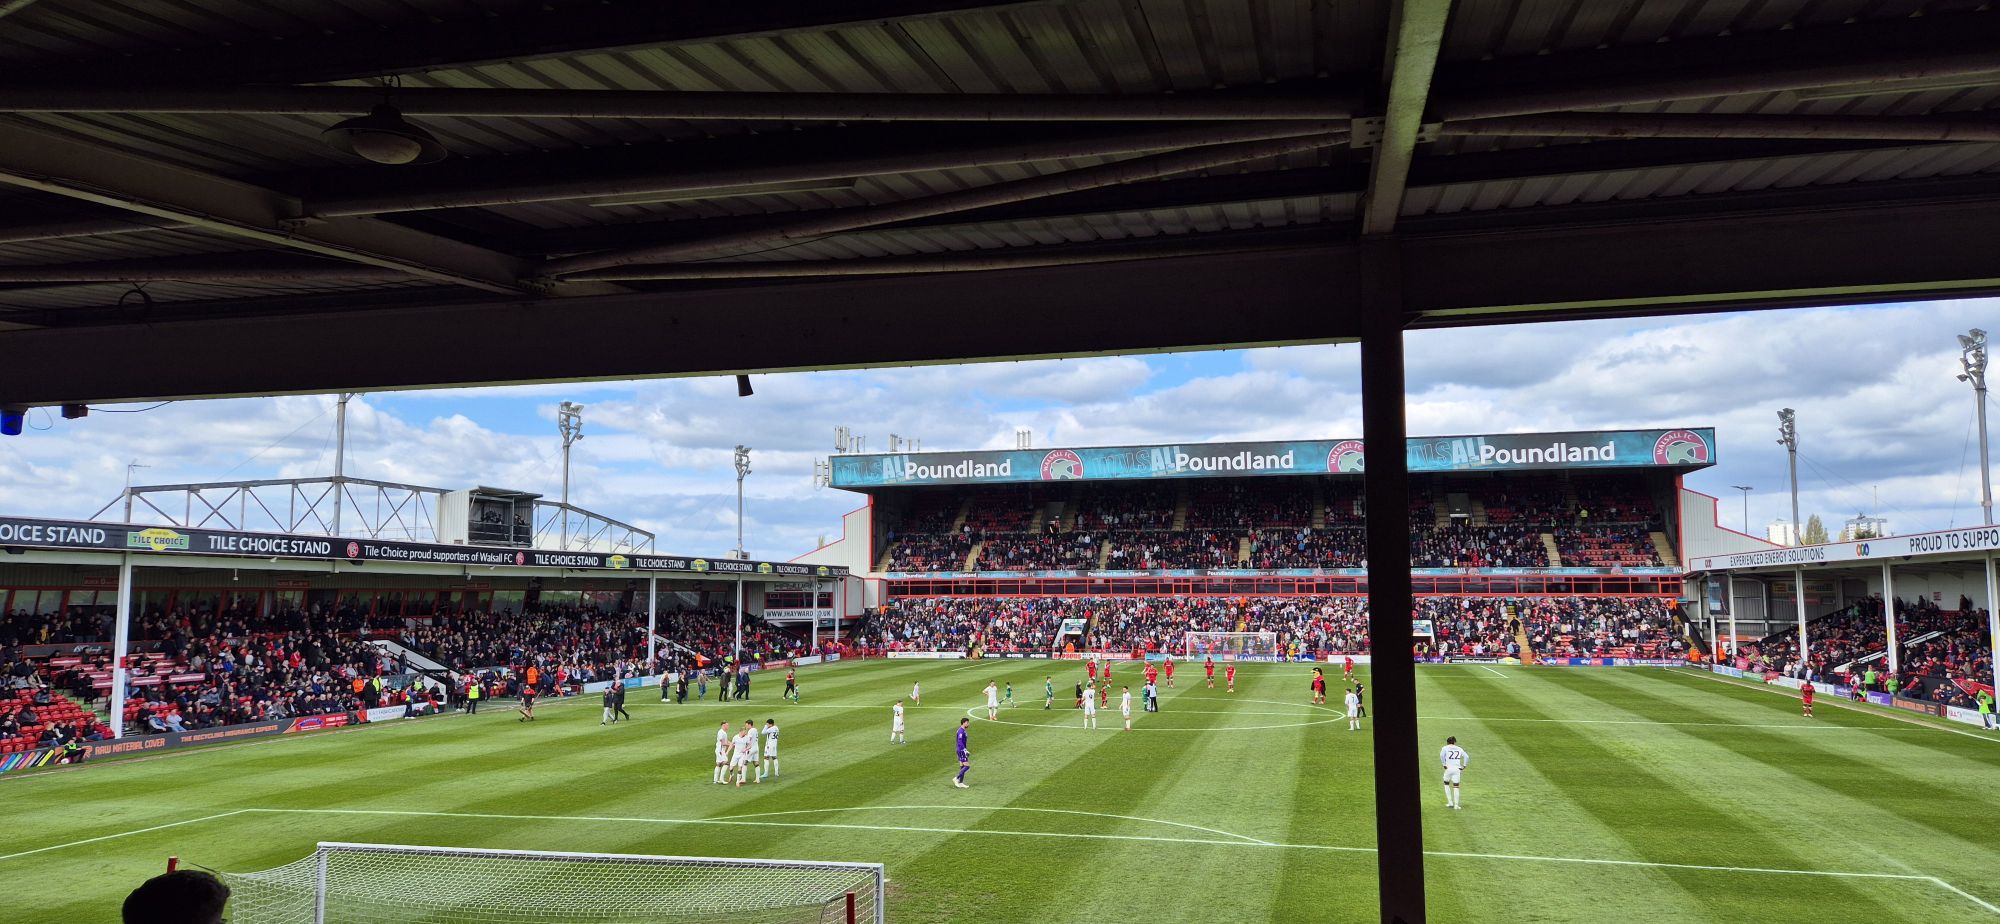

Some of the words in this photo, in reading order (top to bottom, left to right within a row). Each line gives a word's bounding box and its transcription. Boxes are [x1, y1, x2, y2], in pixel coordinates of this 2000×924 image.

[1480, 440, 1614, 464] Poundland
[1656, 432, 1681, 454] WALSALL
[1044, 452, 1063, 472] WALSALL
[1176, 450, 1294, 472] Poundland
[1330, 442, 1352, 464] WALSALL
[904, 459, 1010, 480] Poundland
[0, 524, 42, 542] OICE
[46, 526, 106, 544] STAND
[1910, 536, 1942, 552] PROUD
[1946, 534, 1960, 549] TO
[1963, 529, 1999, 548] SUPPO
[208, 536, 236, 550] TILE
[239, 537, 288, 553] CHOICE
[290, 540, 330, 554] STAND
[364, 545, 379, 556] Tile
[381, 546, 408, 558] Choice
[410, 549, 432, 560] proud
[433, 551, 470, 561] supporters
[471, 552, 479, 561] of
[480, 552, 502, 562] Walsall
[504, 554, 513, 562] FC
[535, 554, 550, 565] TILE
[550, 555, 576, 566] CHOICE
[577, 556, 598, 566] STAND
[636, 558, 647, 567] TILE
[648, 559, 668, 568] CHOICE
[668, 560, 685, 569] STAND
[714, 562, 723, 570] TILE
[723, 562, 738, 570] CHOICE
[1730, 554, 1763, 566] EXPERIENCED
[1765, 552, 1787, 564] ENERGY
[1789, 548, 1824, 562] SOLUTIONS
[193, 732, 224, 740] RECYCLING
[225, 728, 255, 736] INSURANCE
[95, 745, 111, 755] RAW
[113, 741, 143, 752] MATERIAL
[145, 738, 166, 748] COVER
[1448, 750, 1460, 760] 22
